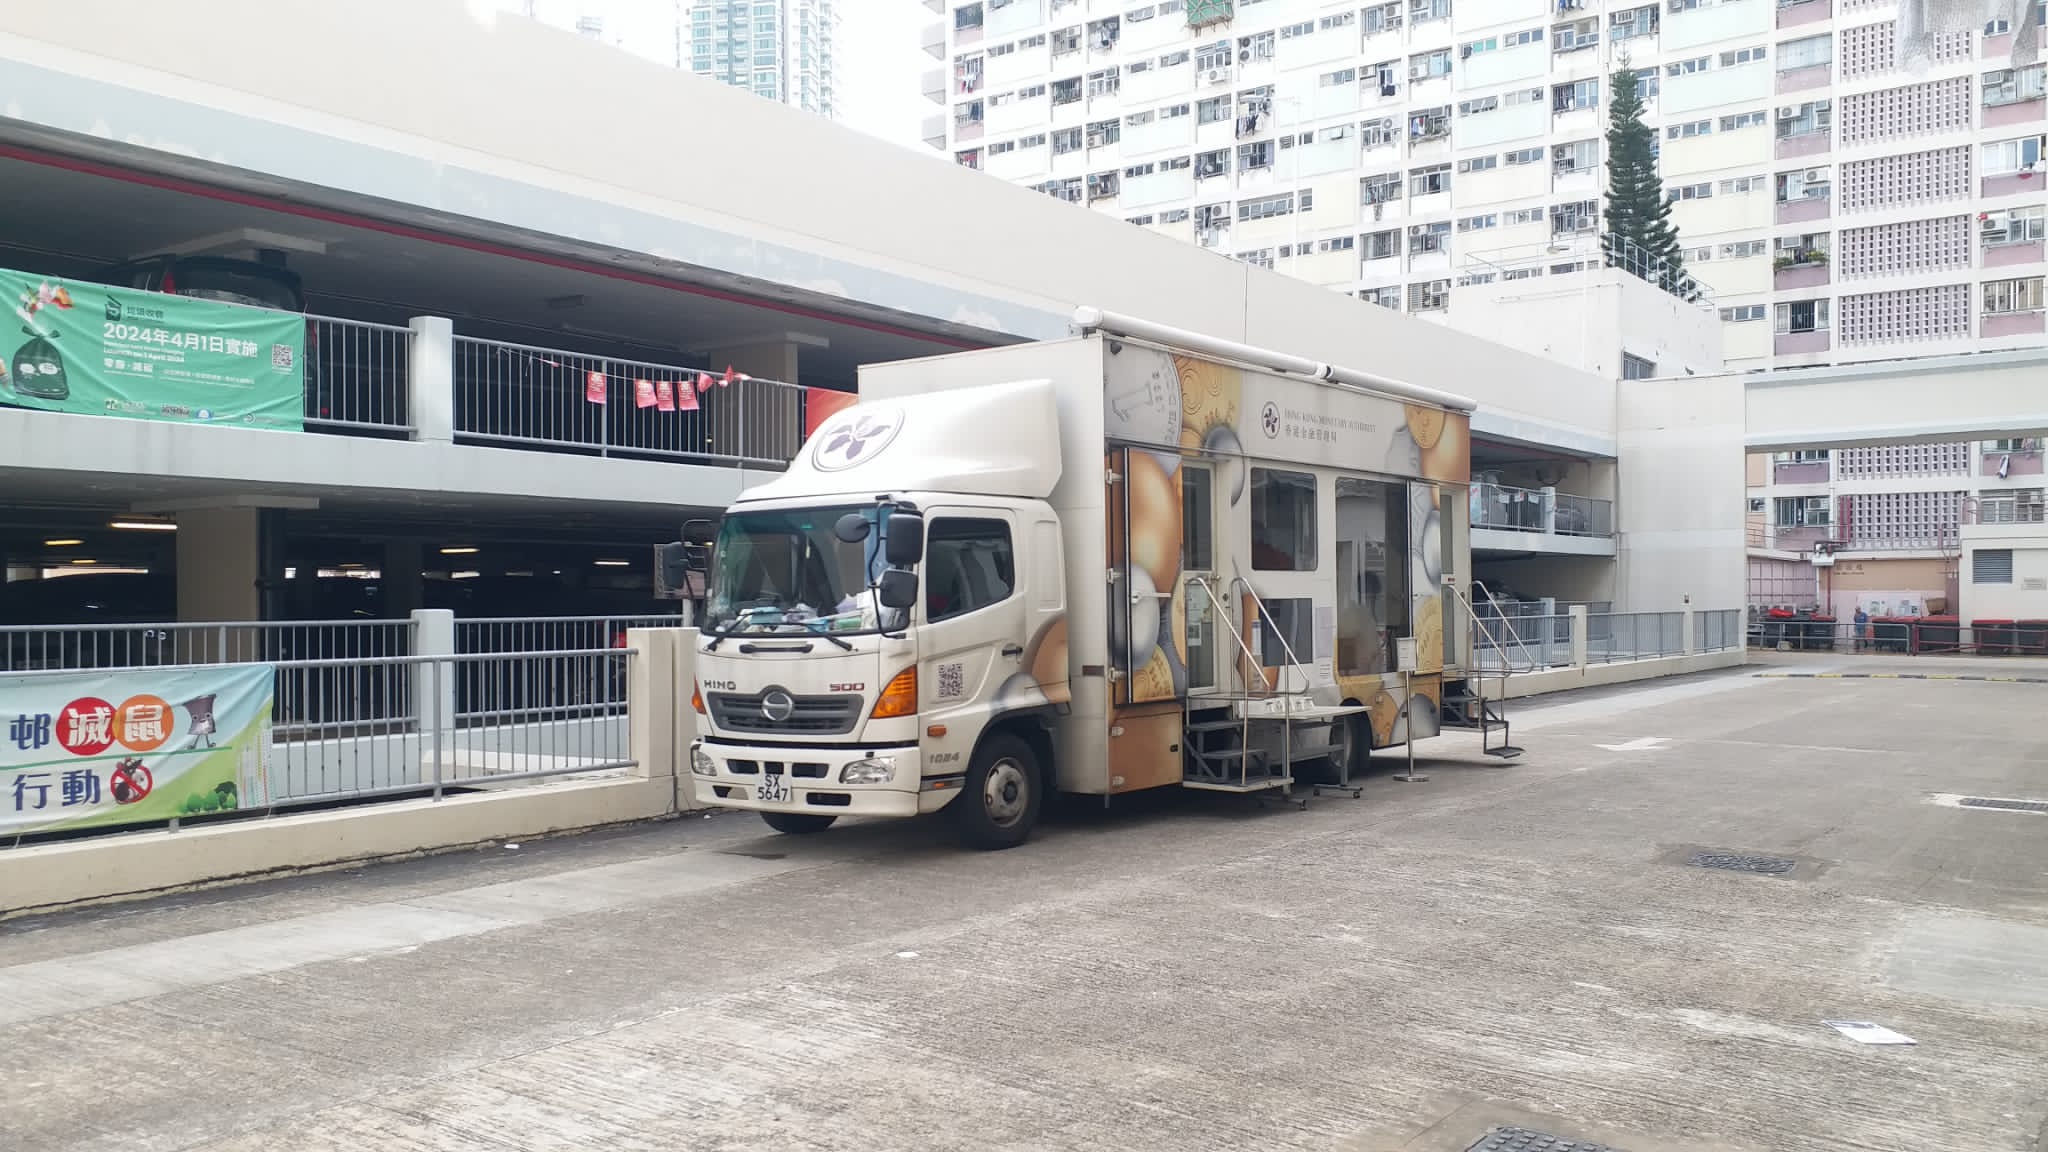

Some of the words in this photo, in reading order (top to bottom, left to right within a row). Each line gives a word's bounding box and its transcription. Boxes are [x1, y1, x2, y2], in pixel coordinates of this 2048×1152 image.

[103, 322, 258, 358] 2024年4月1日實施
[703, 679, 737, 690] HINO
[829, 682, 865, 692] 500
[10, 704, 166, 750] 邨滅鼠
[765, 774, 780, 788] SX
[12, 768, 100, 811] 行動
[757, 786, 789, 801] 5647
